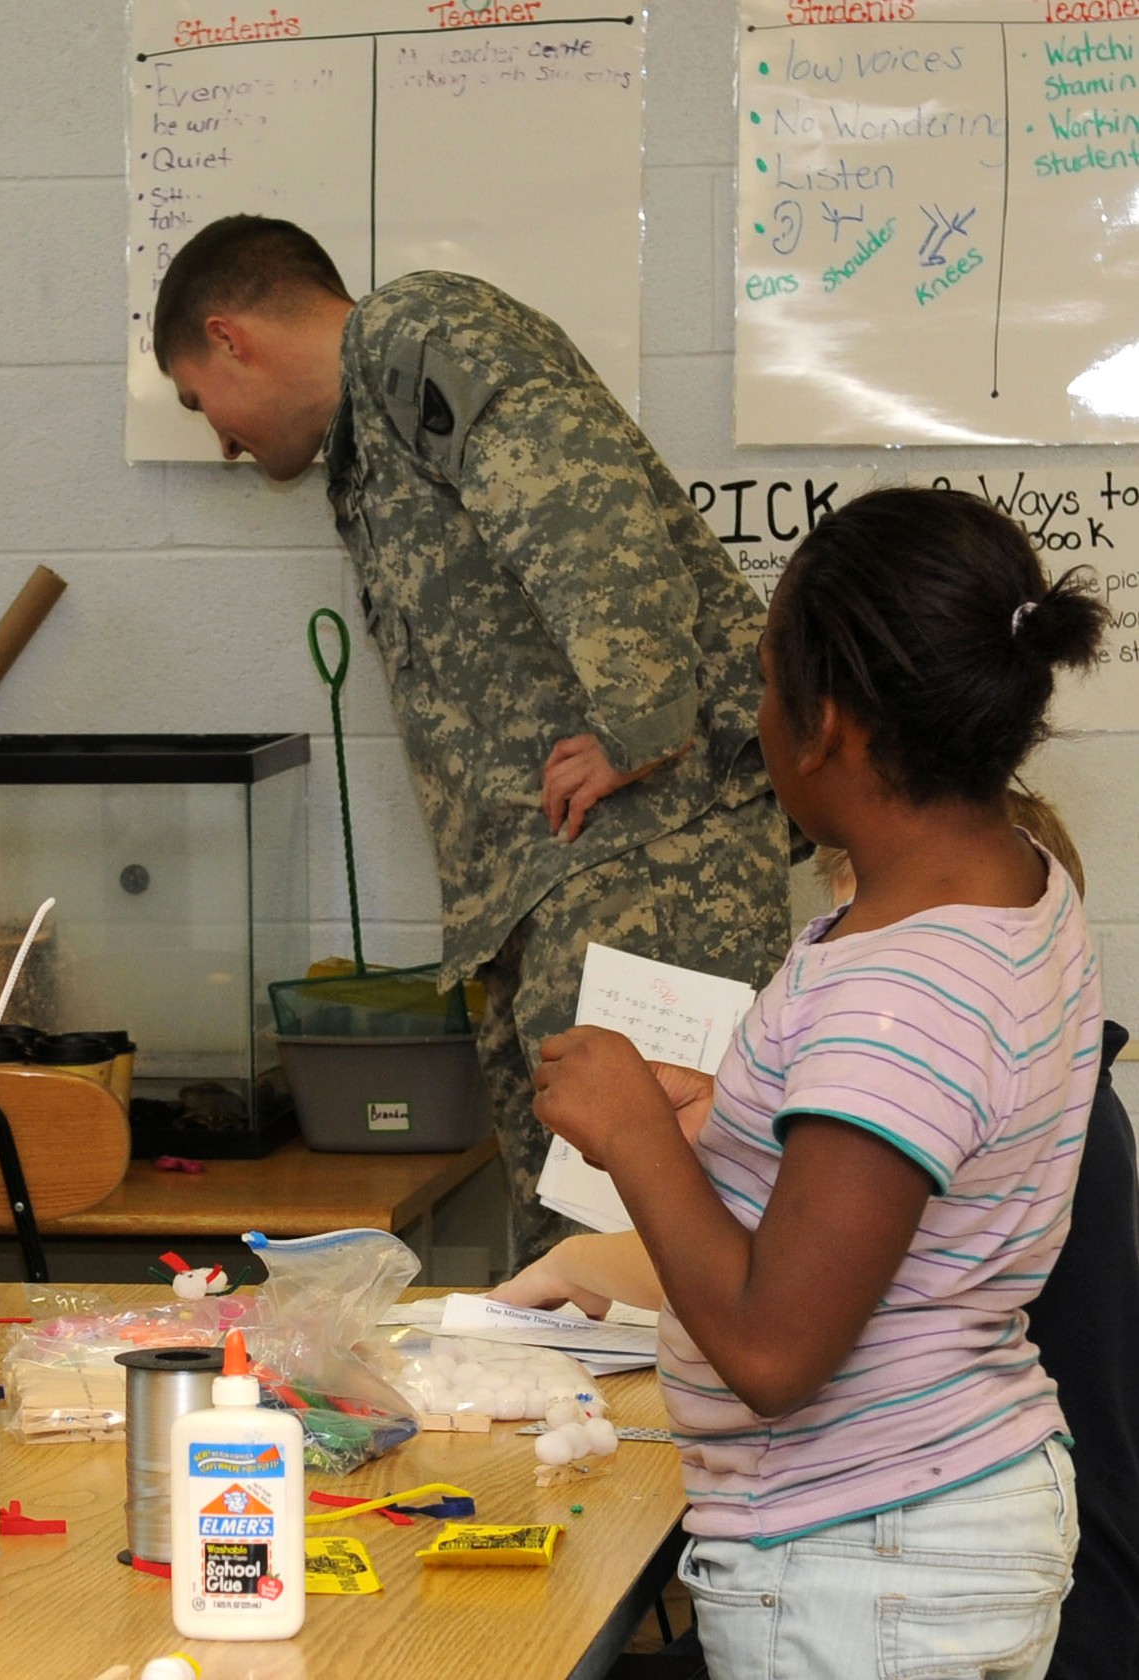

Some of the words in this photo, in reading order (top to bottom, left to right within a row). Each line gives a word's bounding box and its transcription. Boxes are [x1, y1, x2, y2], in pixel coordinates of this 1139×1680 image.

[428, 0, 542, 28] Teacher
[1046, 0, 1139, 23] Teache
[174, 9, 302, 47] Students
[1045, 31, 1136, 67] Watchi
[774, 98, 815, 135] No
[1049, 107, 1139, 140] Workin
[152, 147, 233, 172] Quiet
[775, 152, 894, 191] Listen
[745, 272, 799, 301] ears
[1100, 471, 1139, 510] to
[689, 478, 839, 543] PICK
[503, 1309, 532, 1322] Minute
[201, 1516, 272, 1535] ELMER'S
[207, 1544, 248, 1554] Washable
[206, 1560, 261, 1578] School
[206, 1576, 243, 1593] Glue
